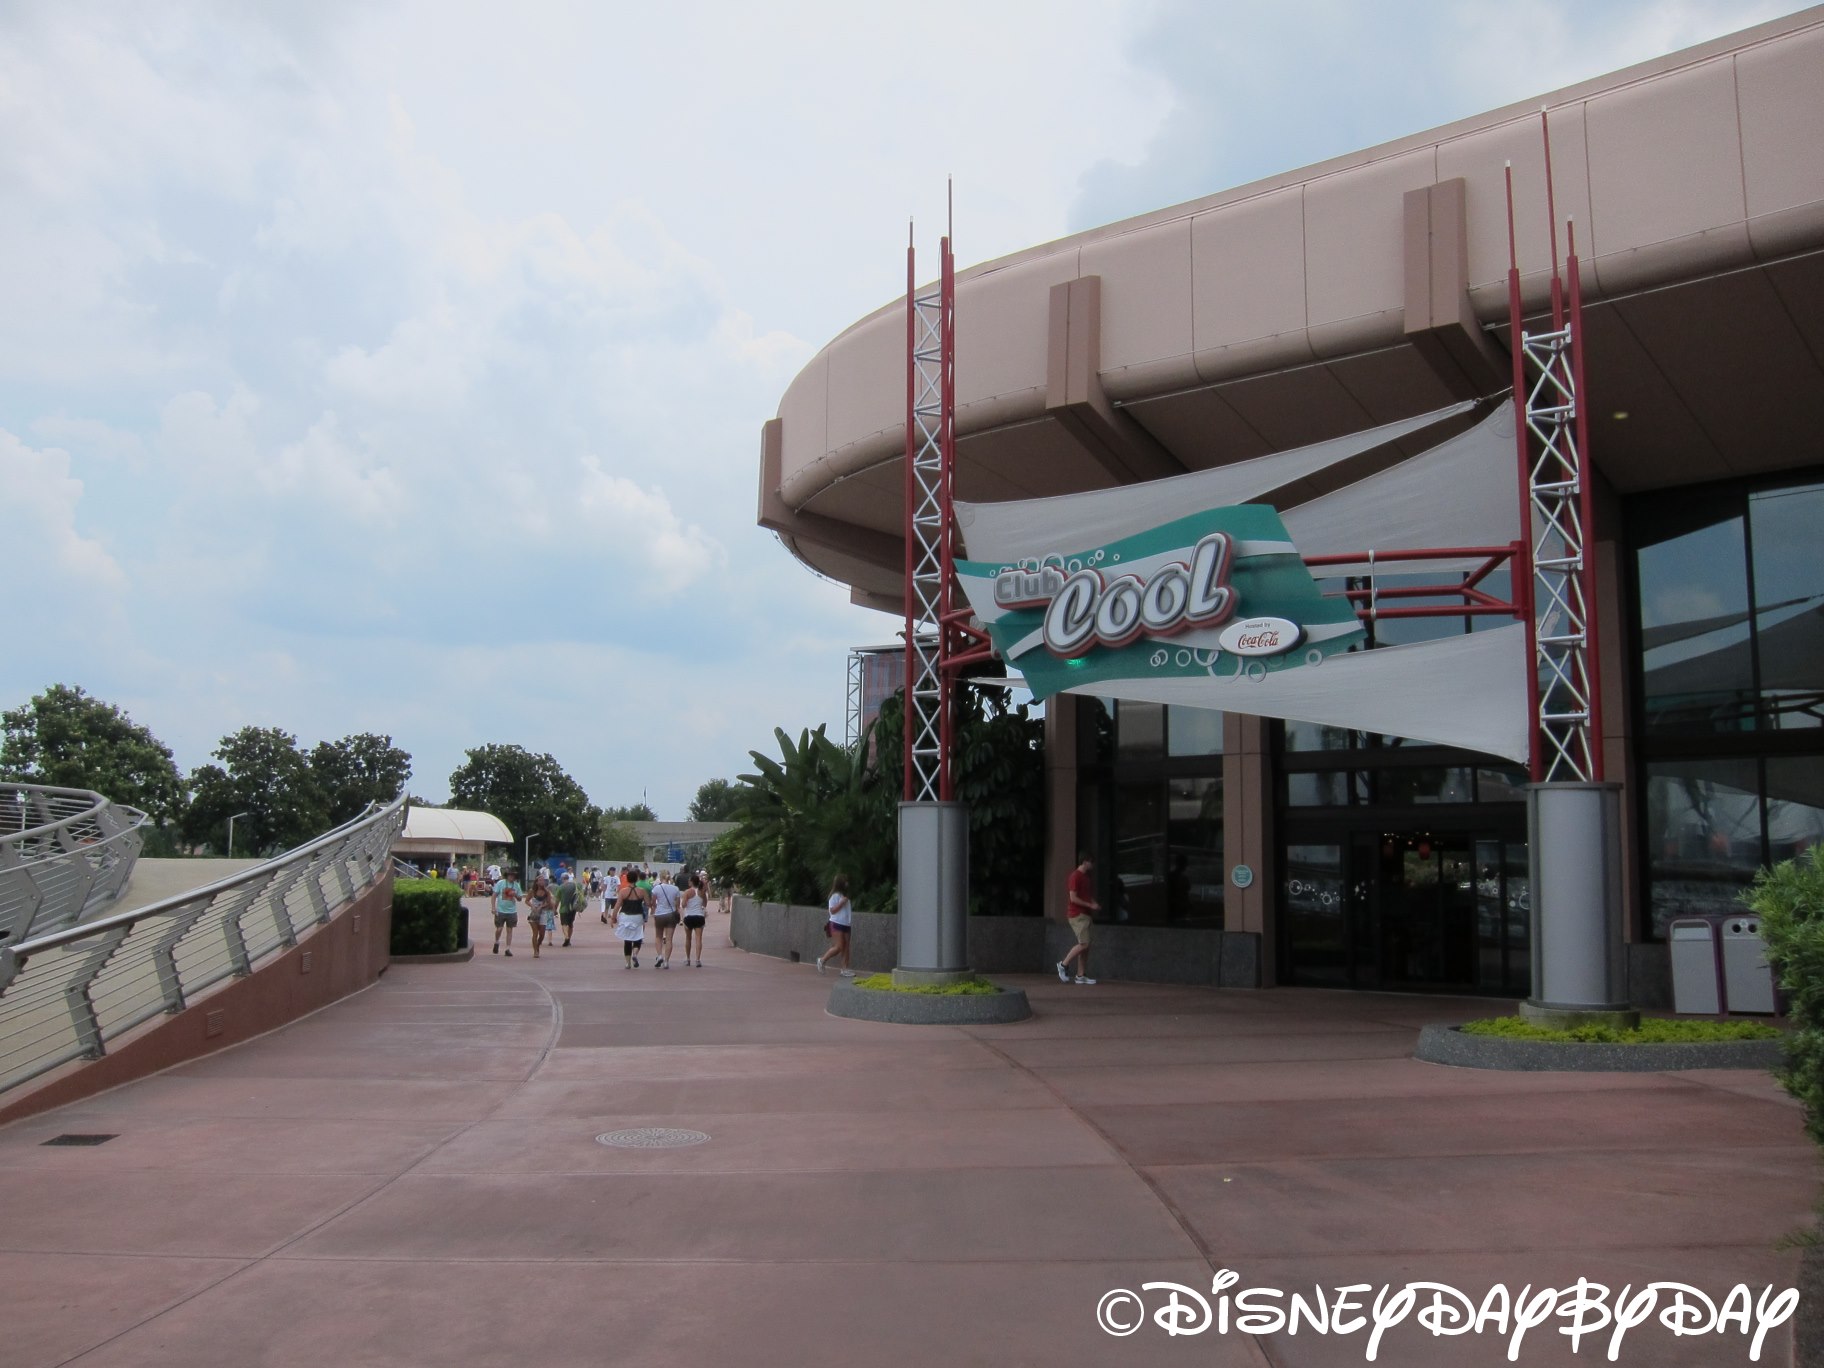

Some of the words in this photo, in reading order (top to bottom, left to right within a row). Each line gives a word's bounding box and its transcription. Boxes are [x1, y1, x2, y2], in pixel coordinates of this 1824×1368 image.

[994, 568, 1064, 602] Club
[1044, 533, 1232, 655] Cool
[1263, 621, 1271, 629] by
